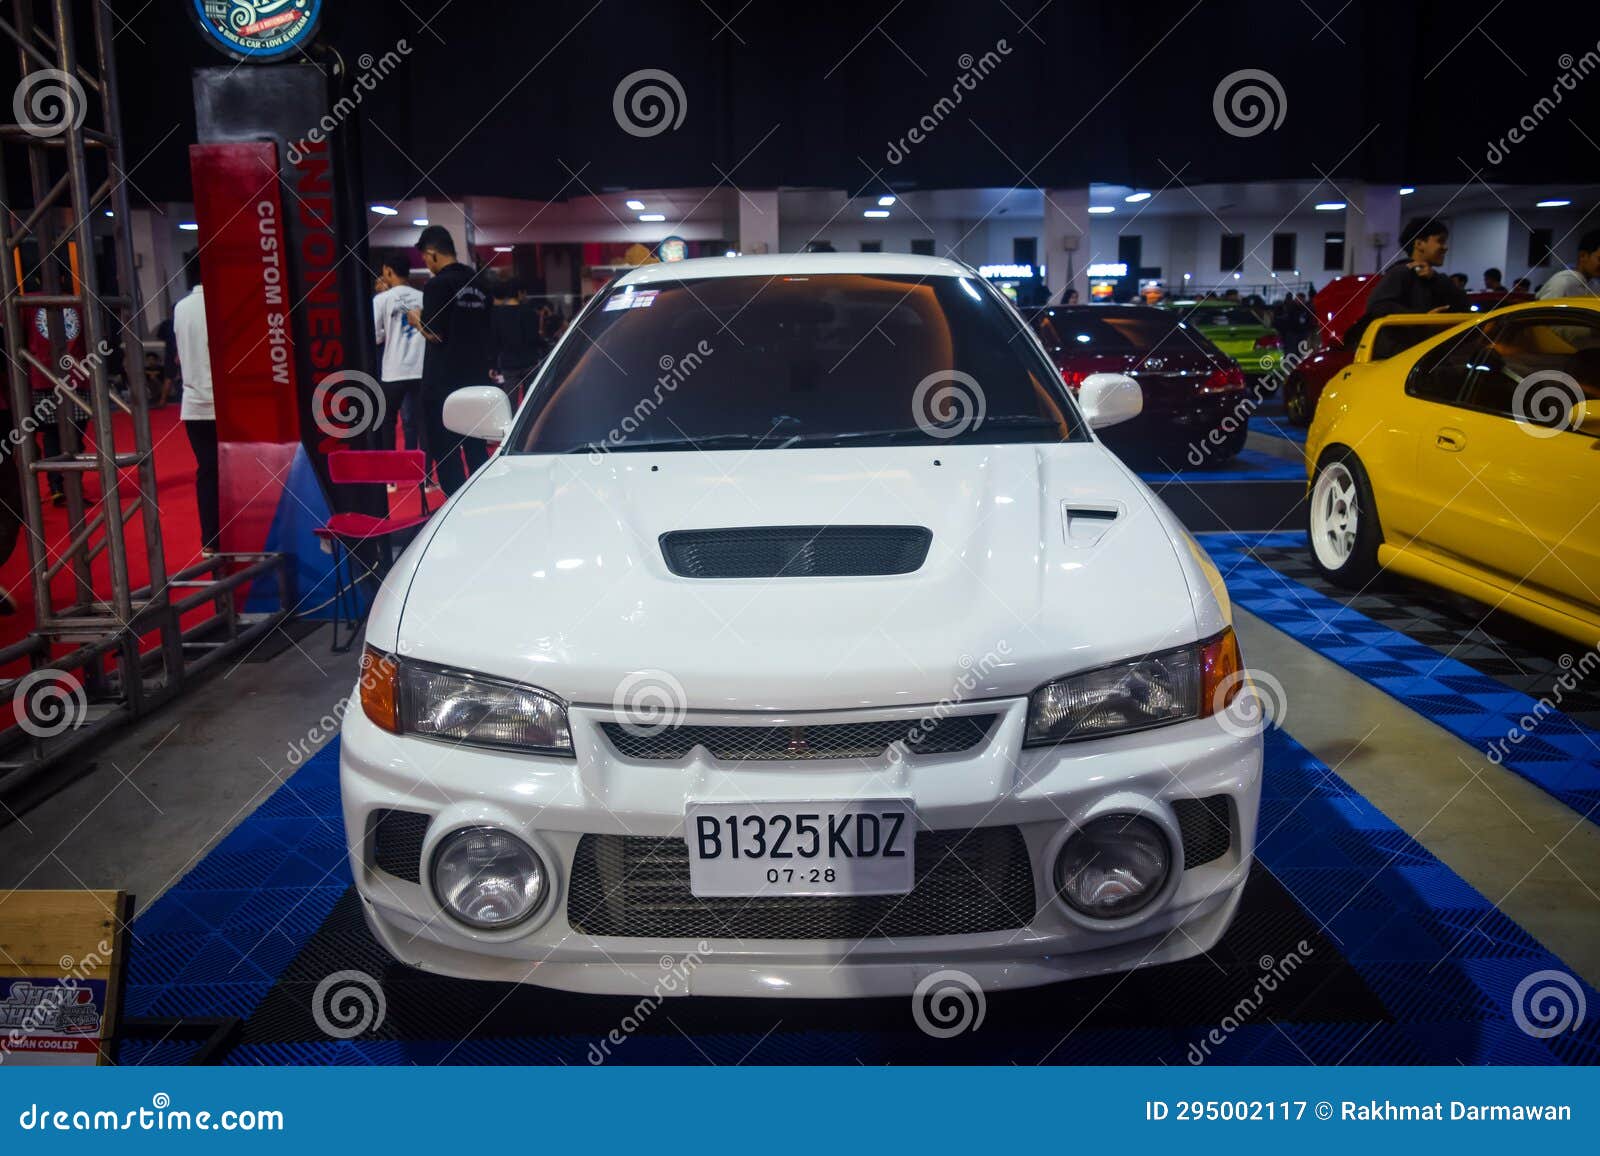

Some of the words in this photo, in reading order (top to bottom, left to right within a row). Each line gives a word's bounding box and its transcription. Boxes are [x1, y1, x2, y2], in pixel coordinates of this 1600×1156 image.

[246, 40, 261, 48] CAR
[266, 38, 283, 48] LOVE
[257, 200, 282, 305] CUSTOM
[267, 312, 290, 385] SHOW
[38, 1040, 79, 1050] COOLEST
